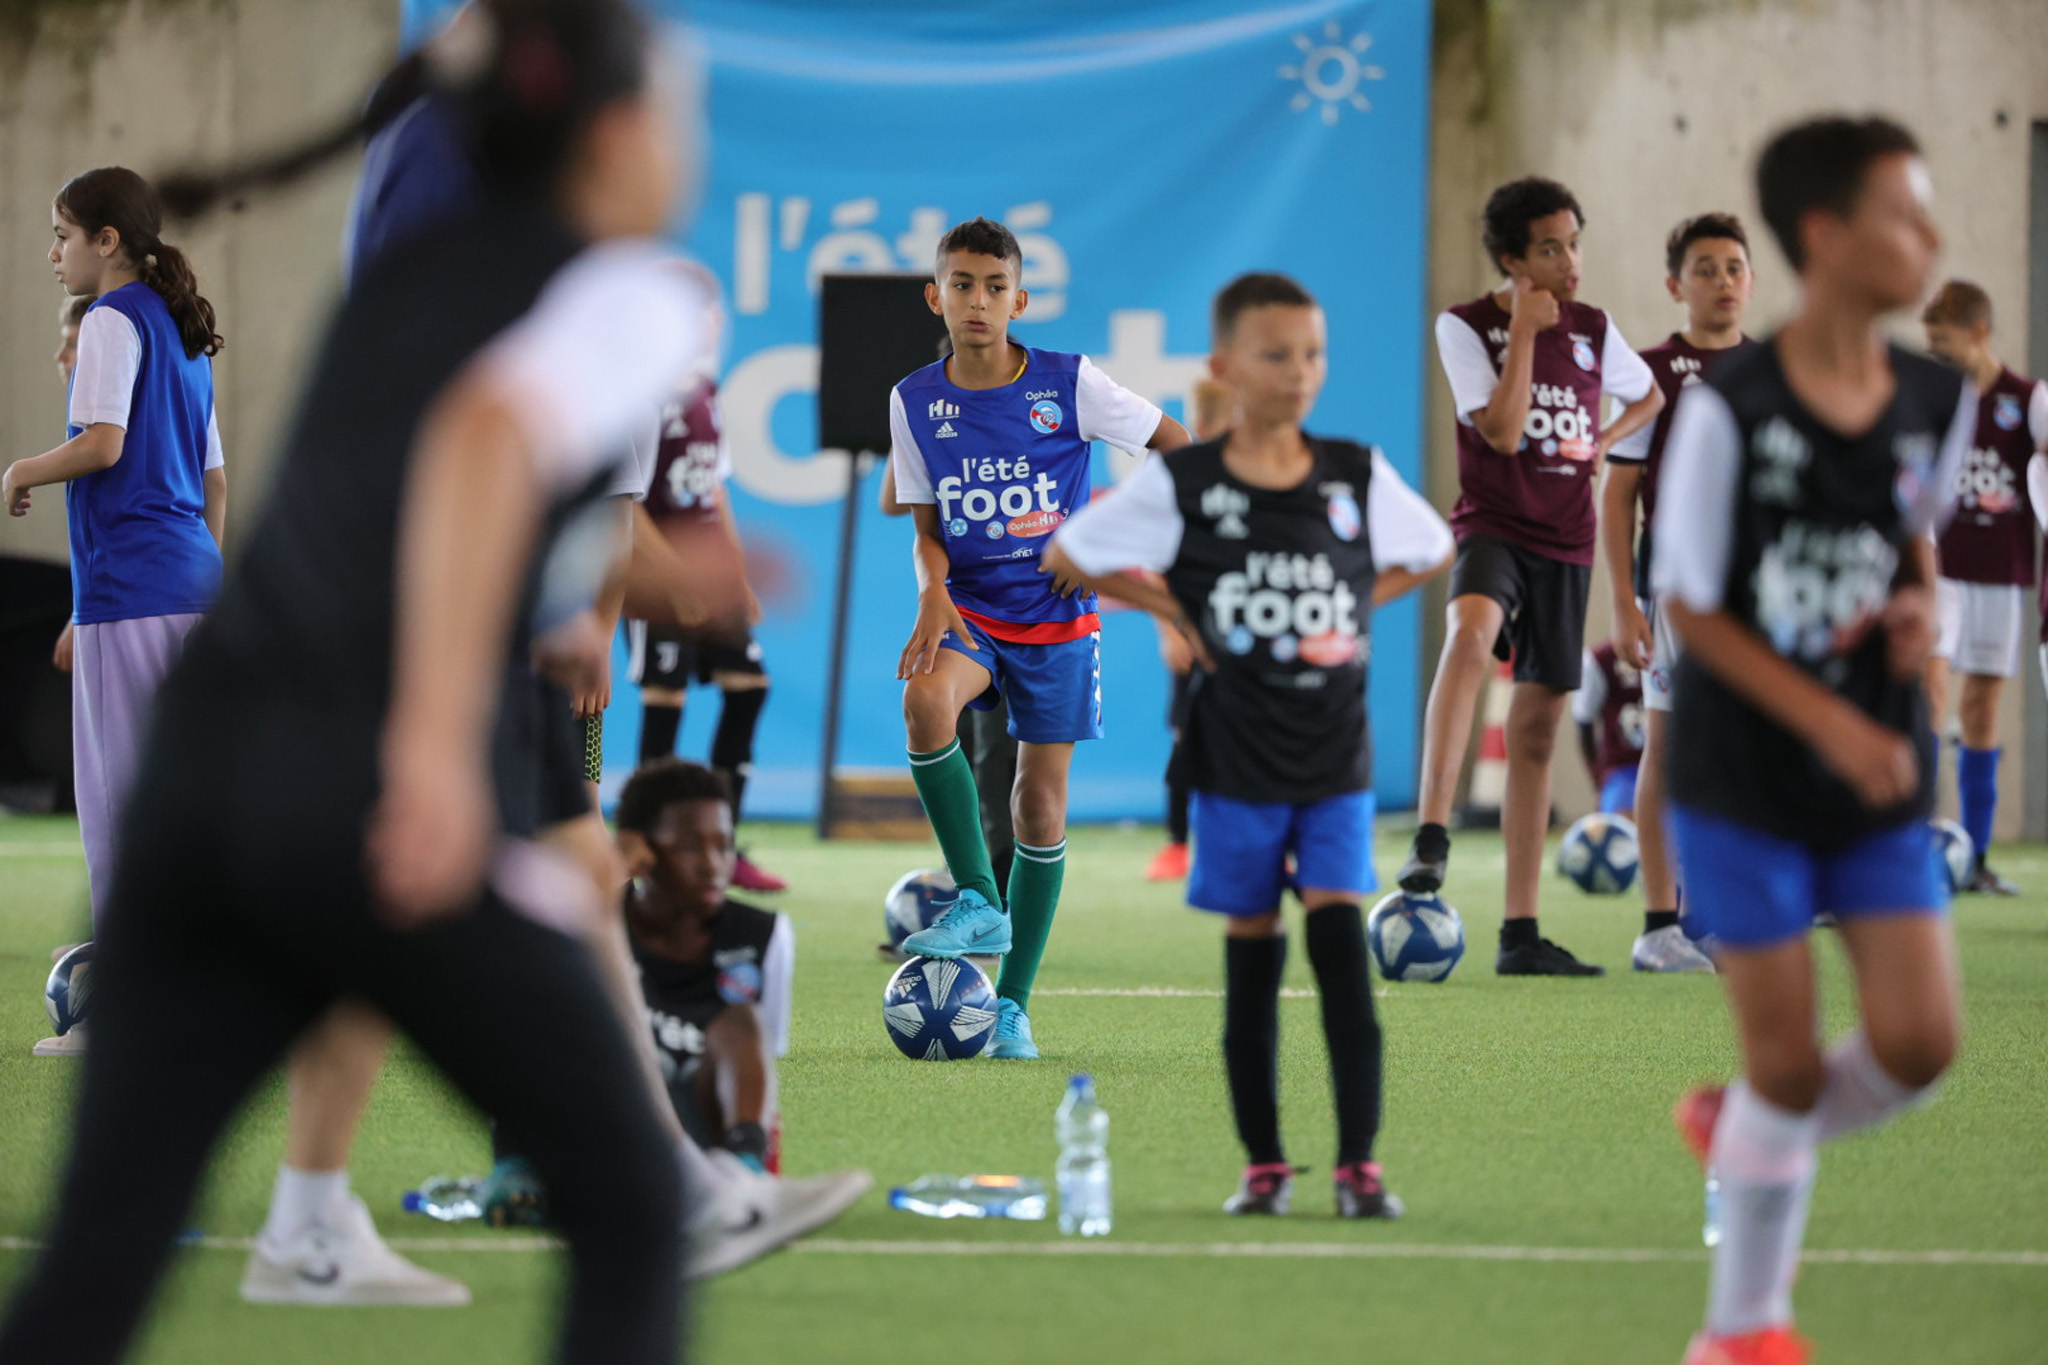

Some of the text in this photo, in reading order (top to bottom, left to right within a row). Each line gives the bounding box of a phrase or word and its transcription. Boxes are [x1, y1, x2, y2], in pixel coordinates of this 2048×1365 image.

[1530, 383, 1577, 410] 'été
[1523, 405, 1594, 444] oot
[962, 455, 1030, 483] l'été
[935, 472, 1060, 521] foot
[1208, 571, 1358, 638] foot
